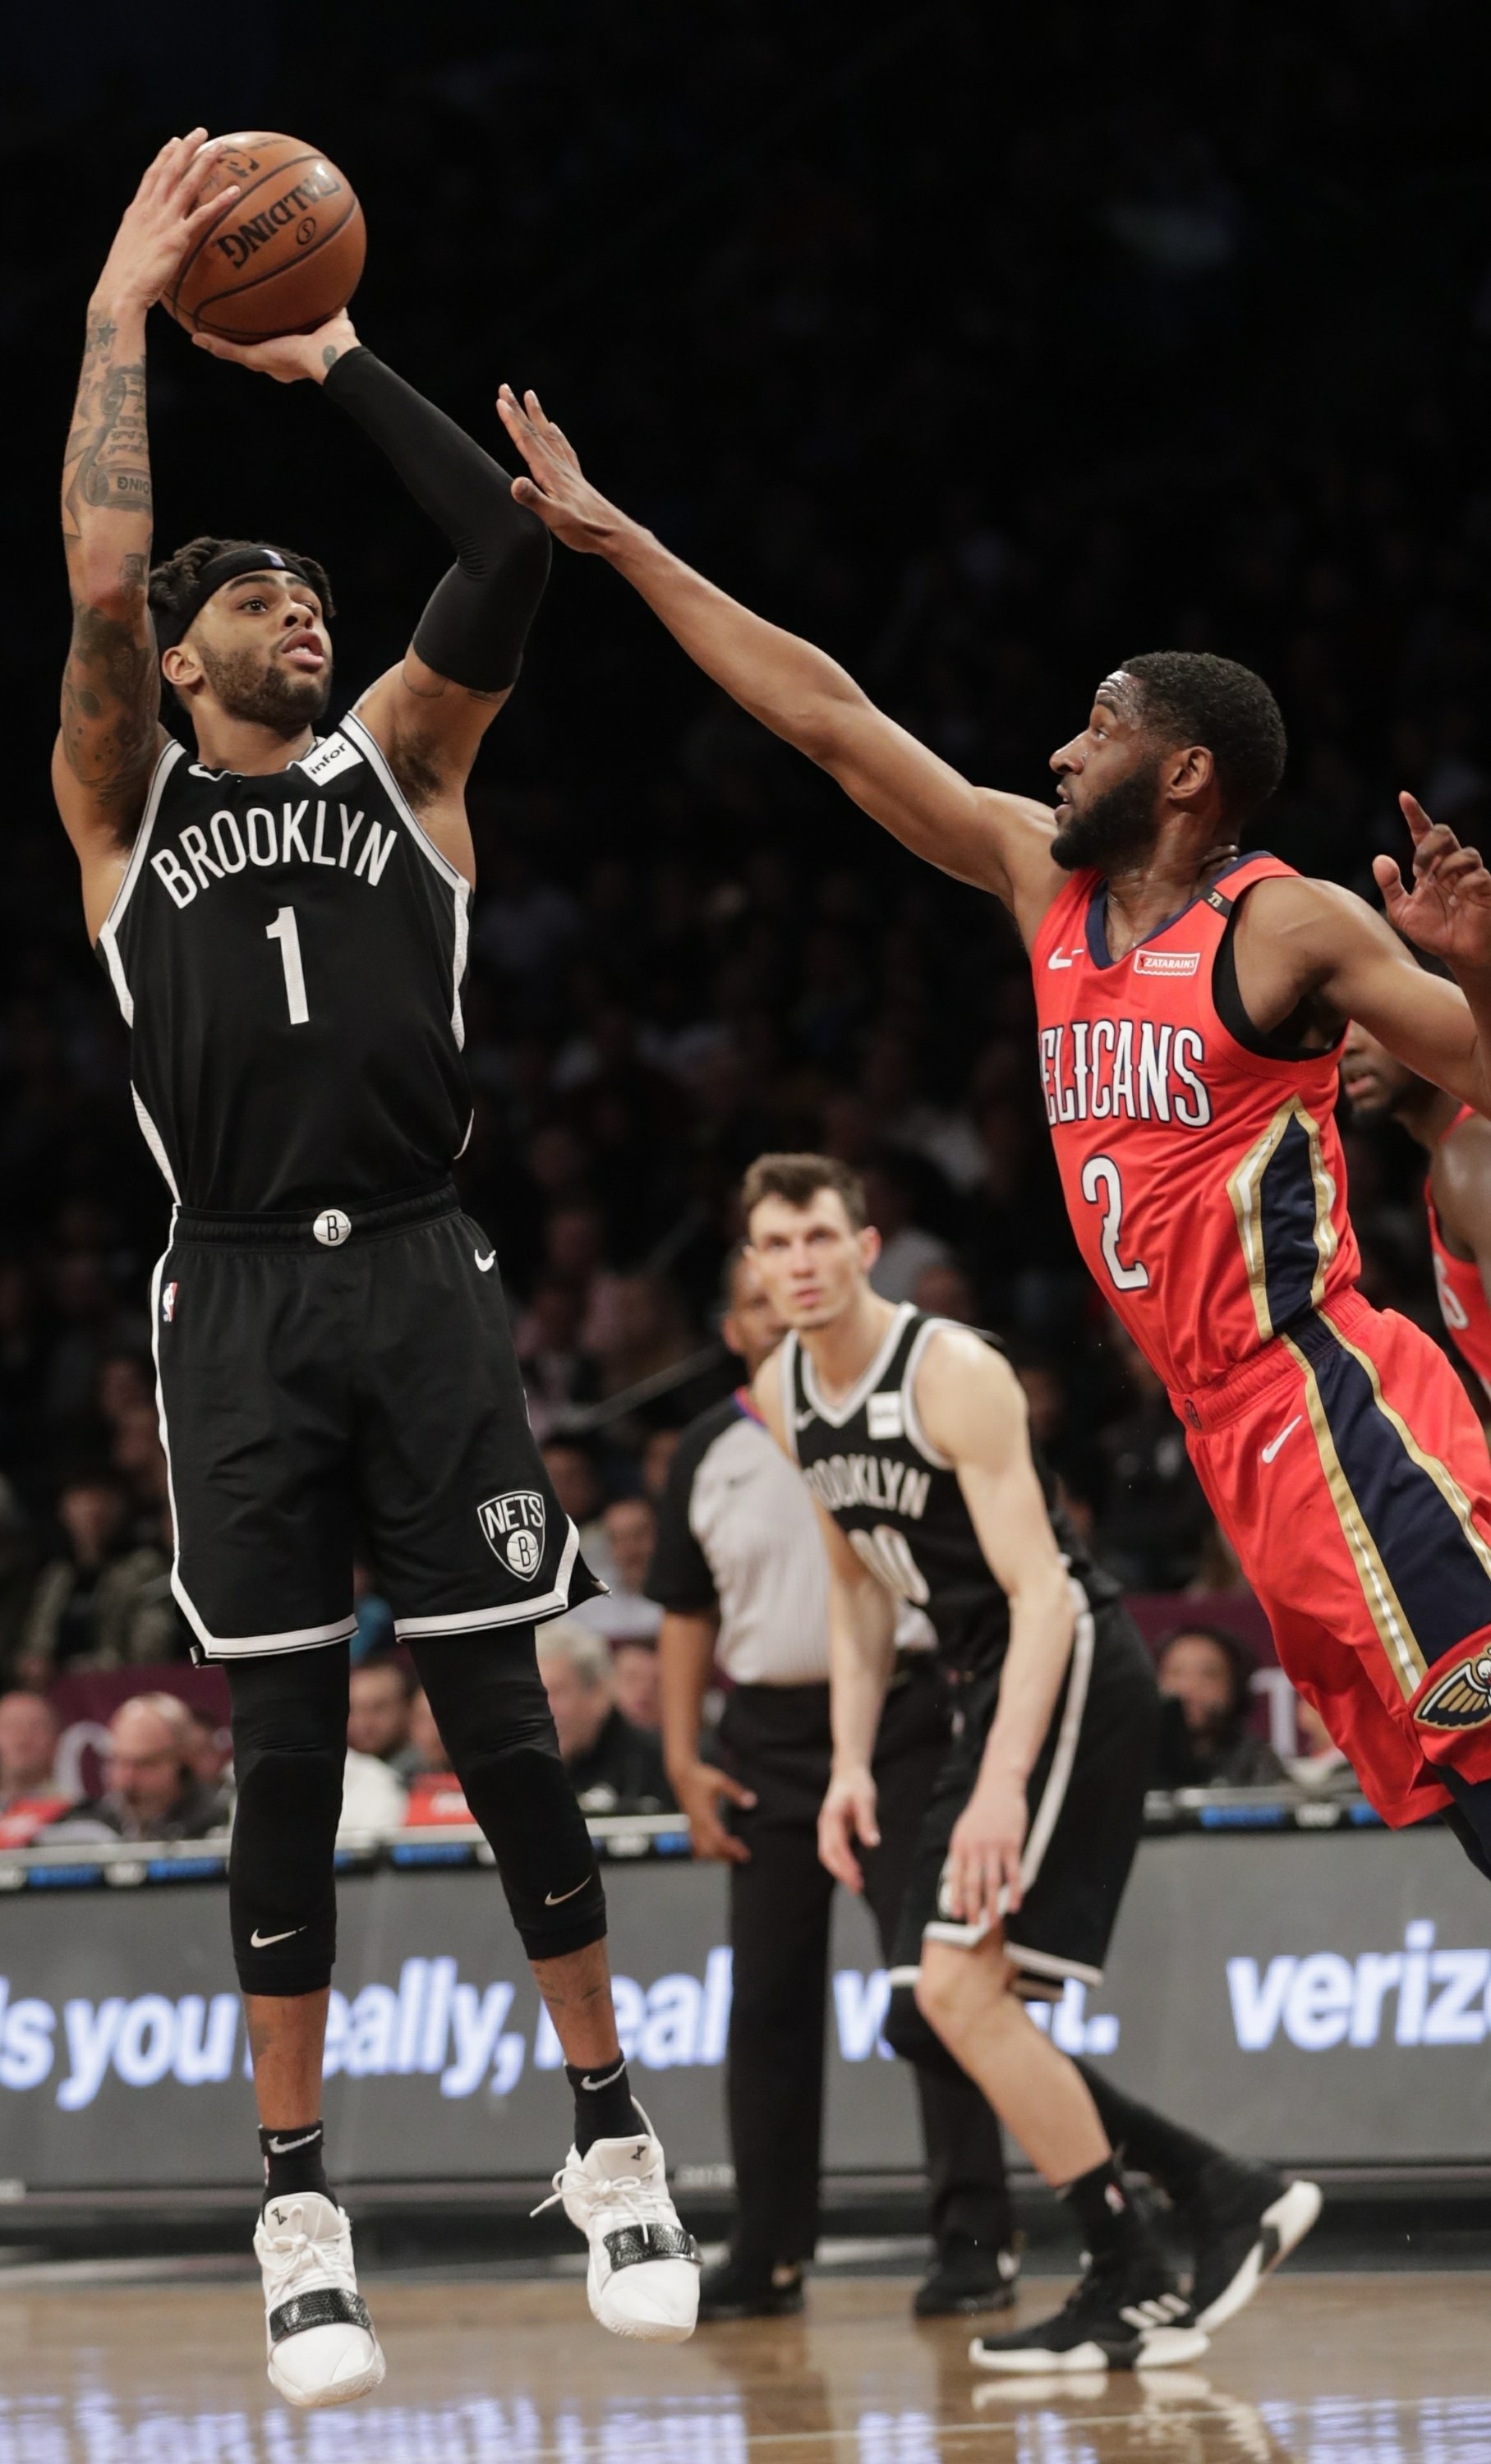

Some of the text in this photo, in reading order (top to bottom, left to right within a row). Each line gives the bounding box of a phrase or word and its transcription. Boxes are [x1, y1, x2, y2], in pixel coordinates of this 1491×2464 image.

[309, 742, 346, 775] infor
[150, 800, 398, 909] BROOKLYN
[265, 906, 310, 1025] 1
[1040, 1019, 1211, 1128] ELICANS
[326, 1215, 339, 1241] B
[1081, 1154, 1149, 1290] 2
[484, 1495, 543, 1540] NETS
[518, 1536, 531, 1567] B
[0, 1976, 56, 2091] s
[55, 1992, 241, 2112] you
[243, 1956, 527, 2099] eally,
[532, 1945, 733, 2071] eal
[1226, 1919, 1491, 2051] veriz
